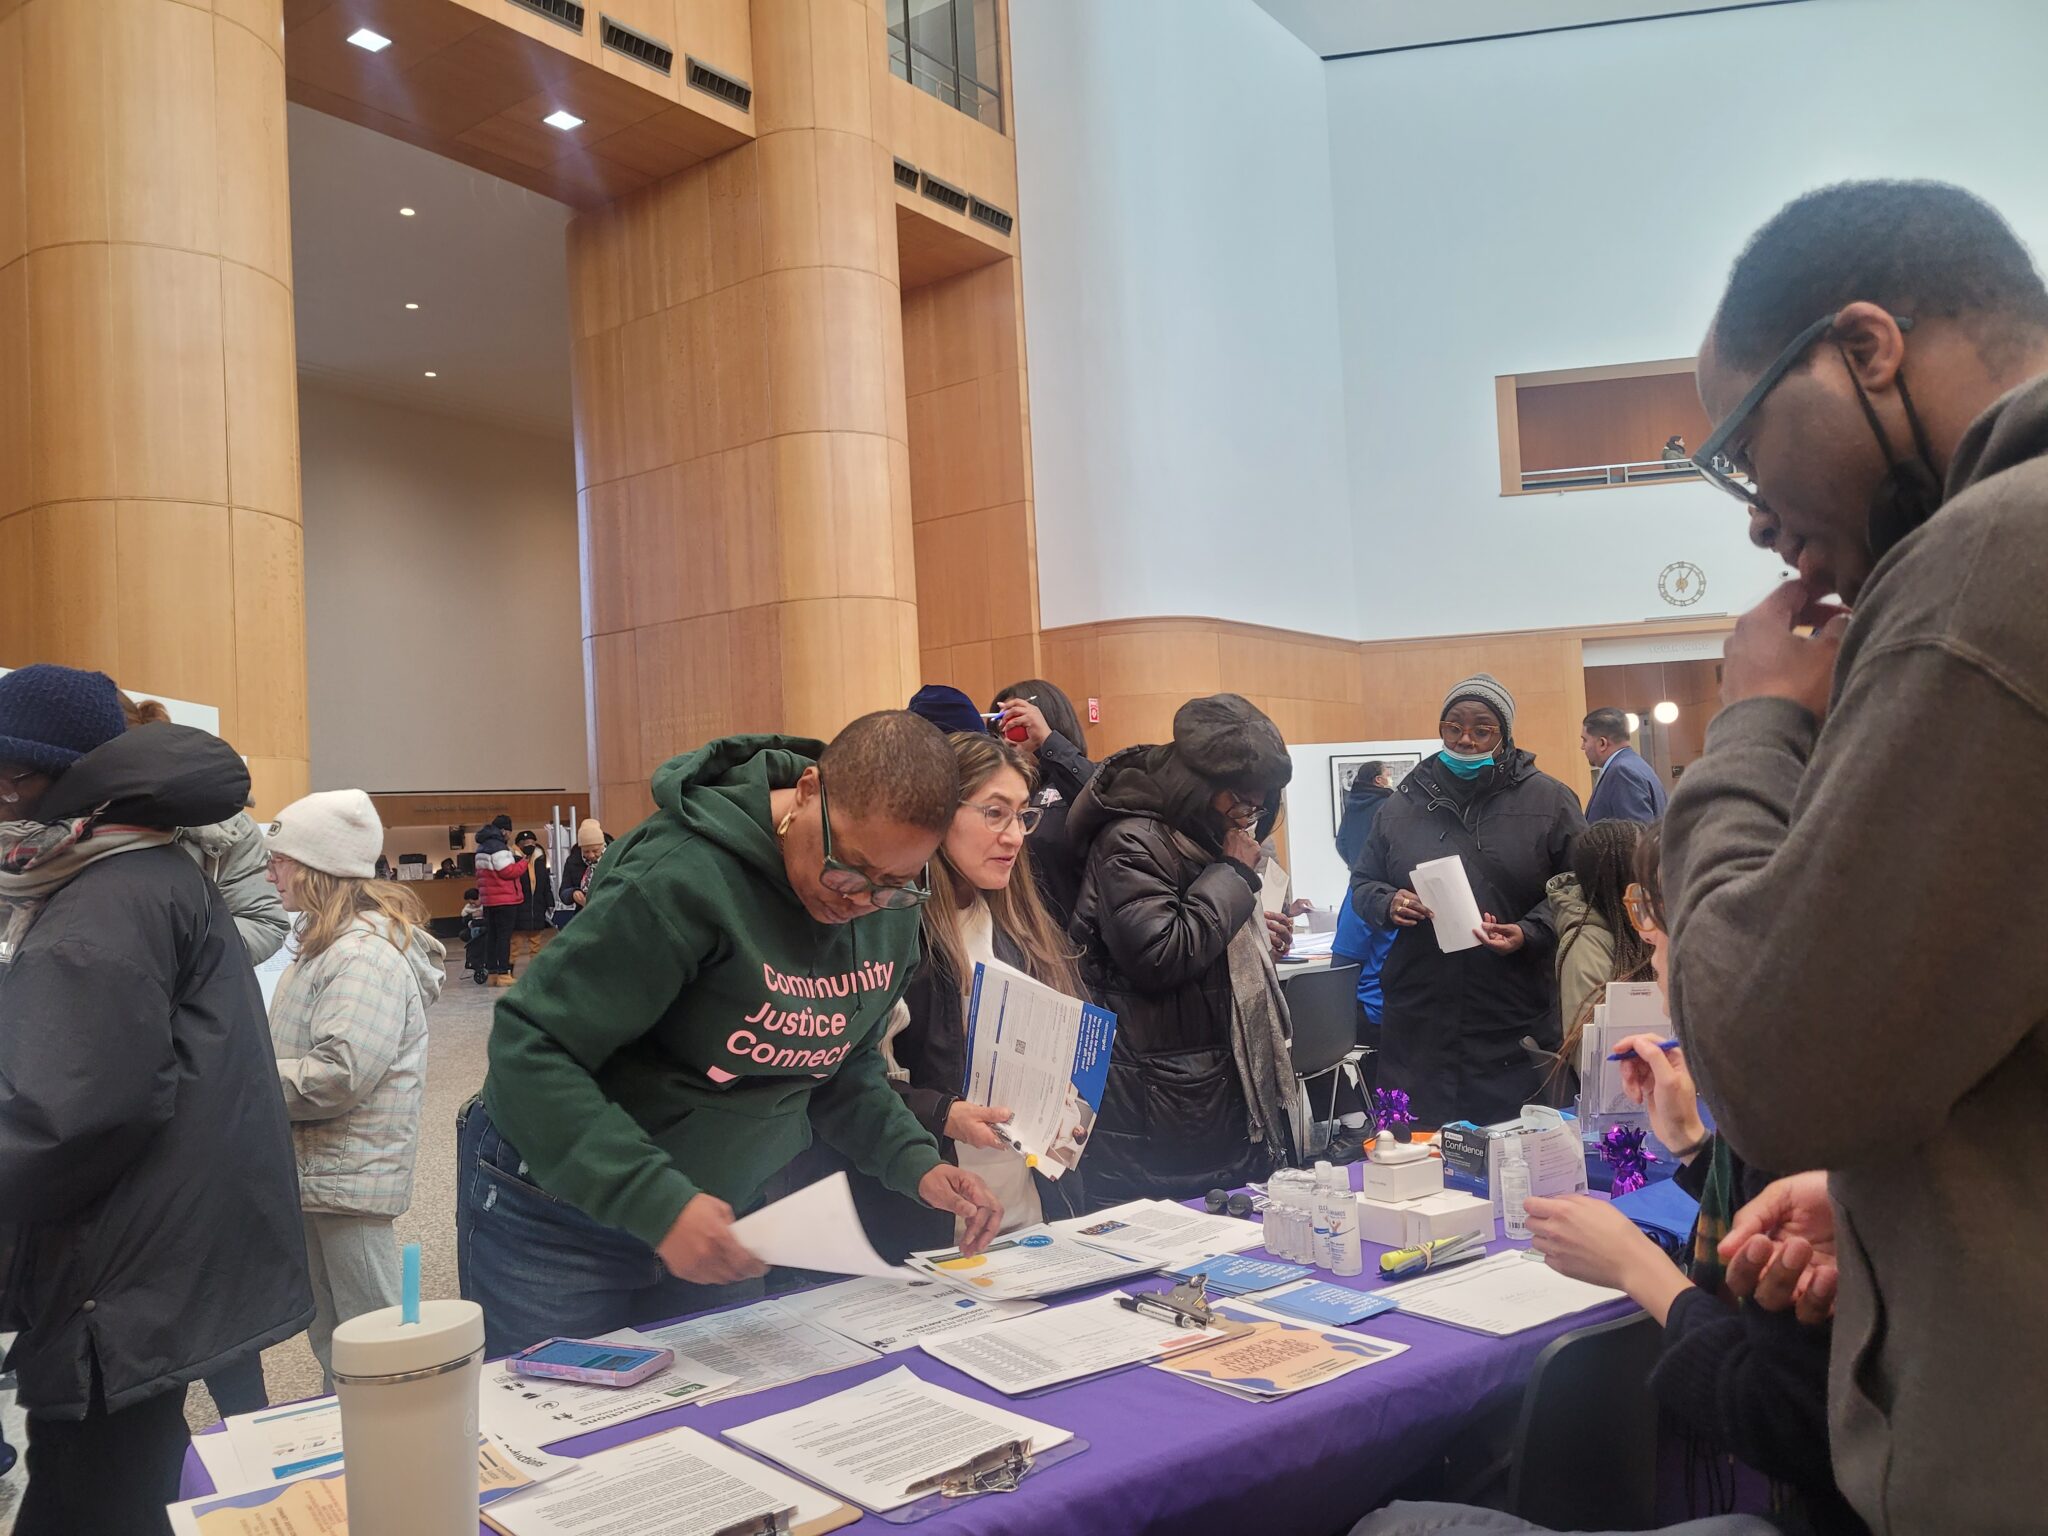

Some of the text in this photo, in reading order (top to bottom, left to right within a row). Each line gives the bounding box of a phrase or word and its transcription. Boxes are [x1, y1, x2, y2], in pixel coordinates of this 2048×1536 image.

[763, 961, 894, 998] Community
[744, 1001, 847, 1037] Justice
[726, 1030, 852, 1067] Connect
[1445, 1140, 1484, 1157] Confidence
[580, 1399, 662, 1425] Deductions
